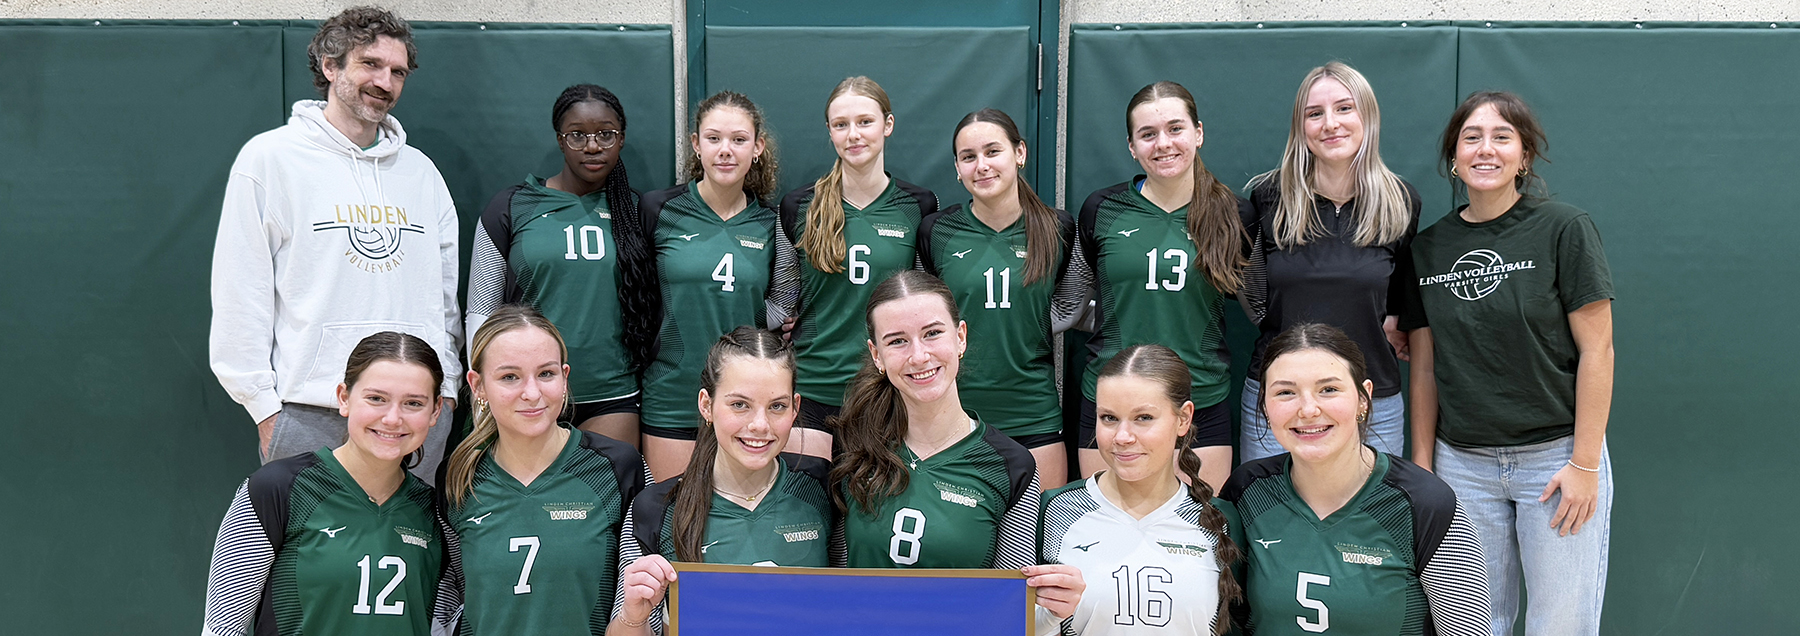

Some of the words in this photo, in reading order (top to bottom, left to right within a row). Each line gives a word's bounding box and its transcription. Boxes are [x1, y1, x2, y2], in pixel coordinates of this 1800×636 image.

[335, 204, 408, 225] LINDEN
[563, 224, 606, 260] 10
[711, 252, 736, 292] 4
[848, 244, 871, 285] 6
[1145, 247, 1189, 292] 13
[1419, 271, 1462, 286] LINDEN
[1463, 260, 1536, 278] VOLLEYBALL
[1444, 278, 1480, 288] VARSITY
[1483, 273, 1509, 283] GIRLS
[983, 267, 1011, 309] 11
[549, 510, 587, 520] WINGS
[940, 490, 978, 508] WINGS
[783, 530, 819, 542] WINGS
[889, 507, 926, 565] 8
[1166, 547, 1202, 558] WINGS
[509, 536, 540, 595] 7
[1342, 552, 1383, 566] WINGS
[352, 554, 407, 615] 12
[1112, 565, 1172, 627] 16
[1296, 572, 1330, 633] 5
